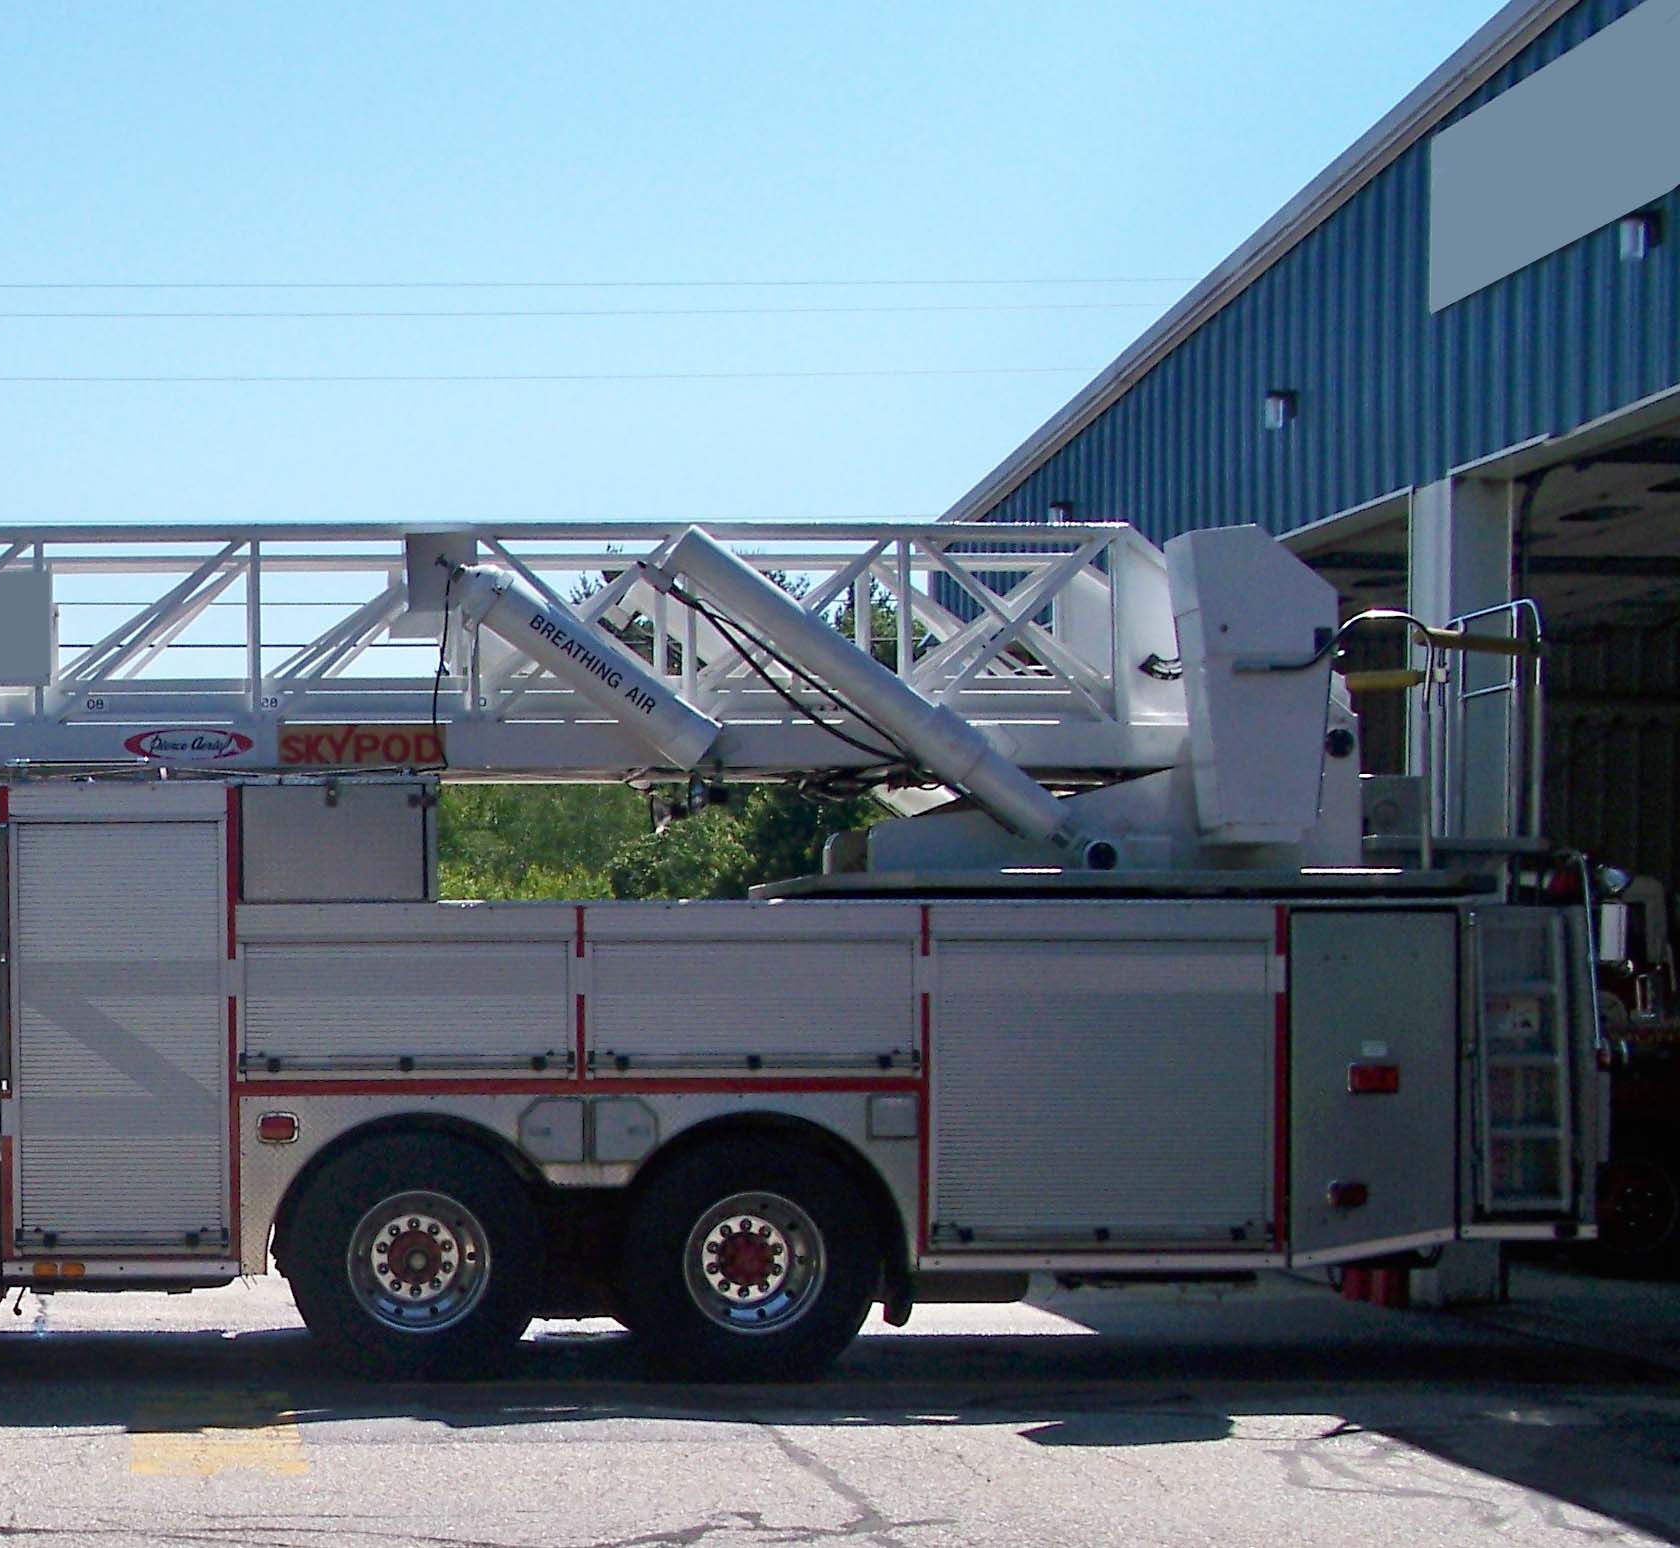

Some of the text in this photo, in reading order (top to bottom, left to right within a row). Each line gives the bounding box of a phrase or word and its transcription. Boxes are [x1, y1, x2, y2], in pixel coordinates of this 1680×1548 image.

[528, 613, 657, 715] BREATHING AIR
[280, 726, 445, 766] SKYPOD
